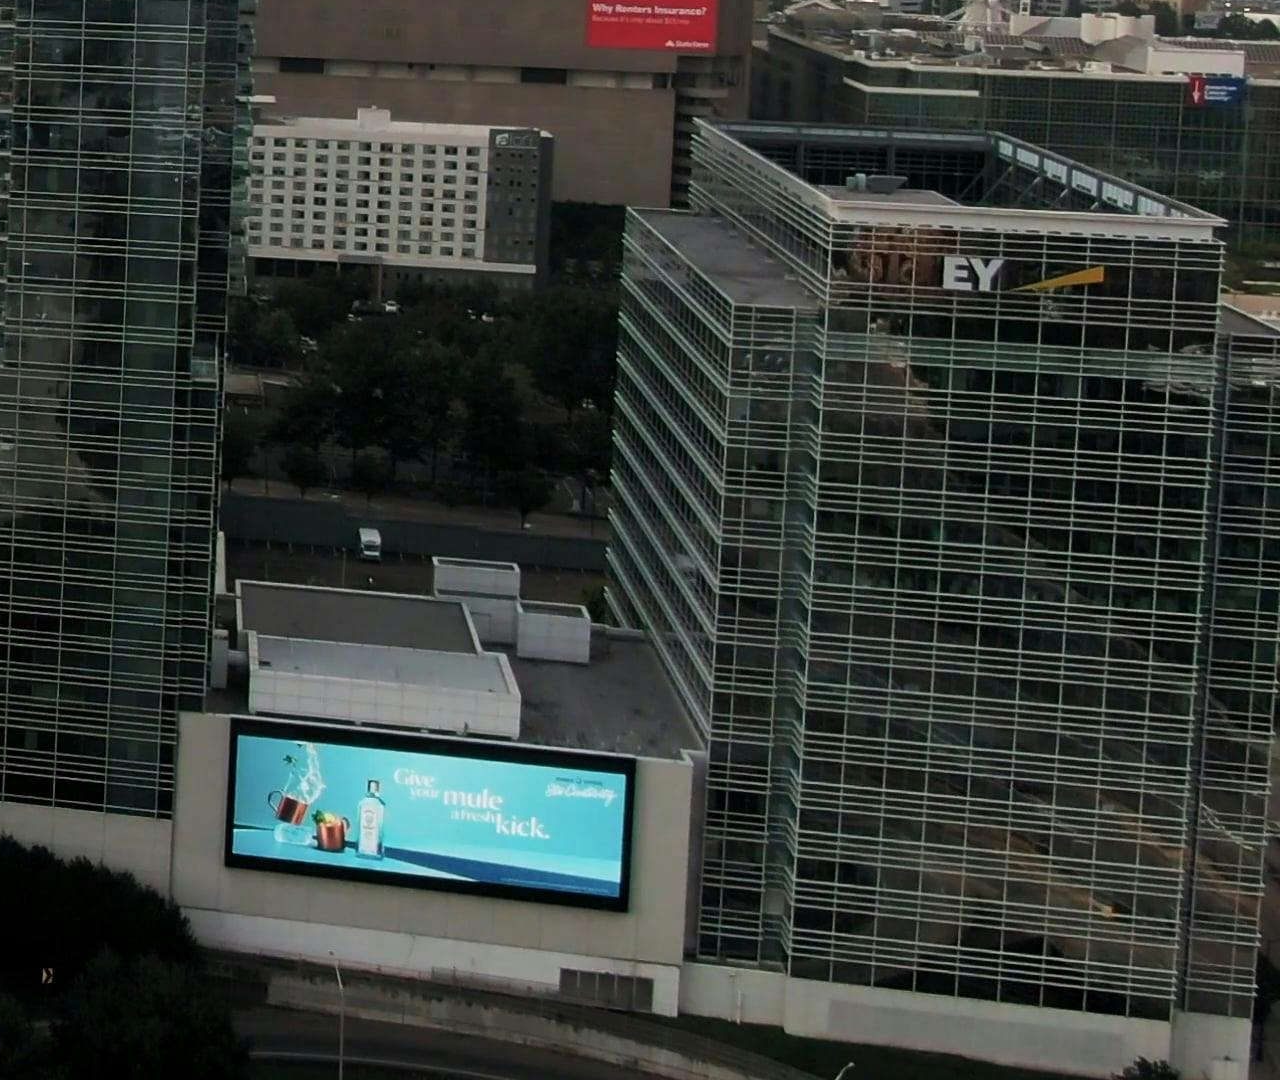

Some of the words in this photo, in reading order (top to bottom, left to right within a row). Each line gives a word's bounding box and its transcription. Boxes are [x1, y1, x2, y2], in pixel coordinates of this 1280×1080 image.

[592, 3, 613, 14] Why
[654, 5, 707, 15] Insurance?
[943, 256, 1005, 291] EY
[393, 768, 435, 787] Give
[410, 787, 439, 800] your
[443, 788, 503, 810] mule
[495, 812, 551, 839] kick.
